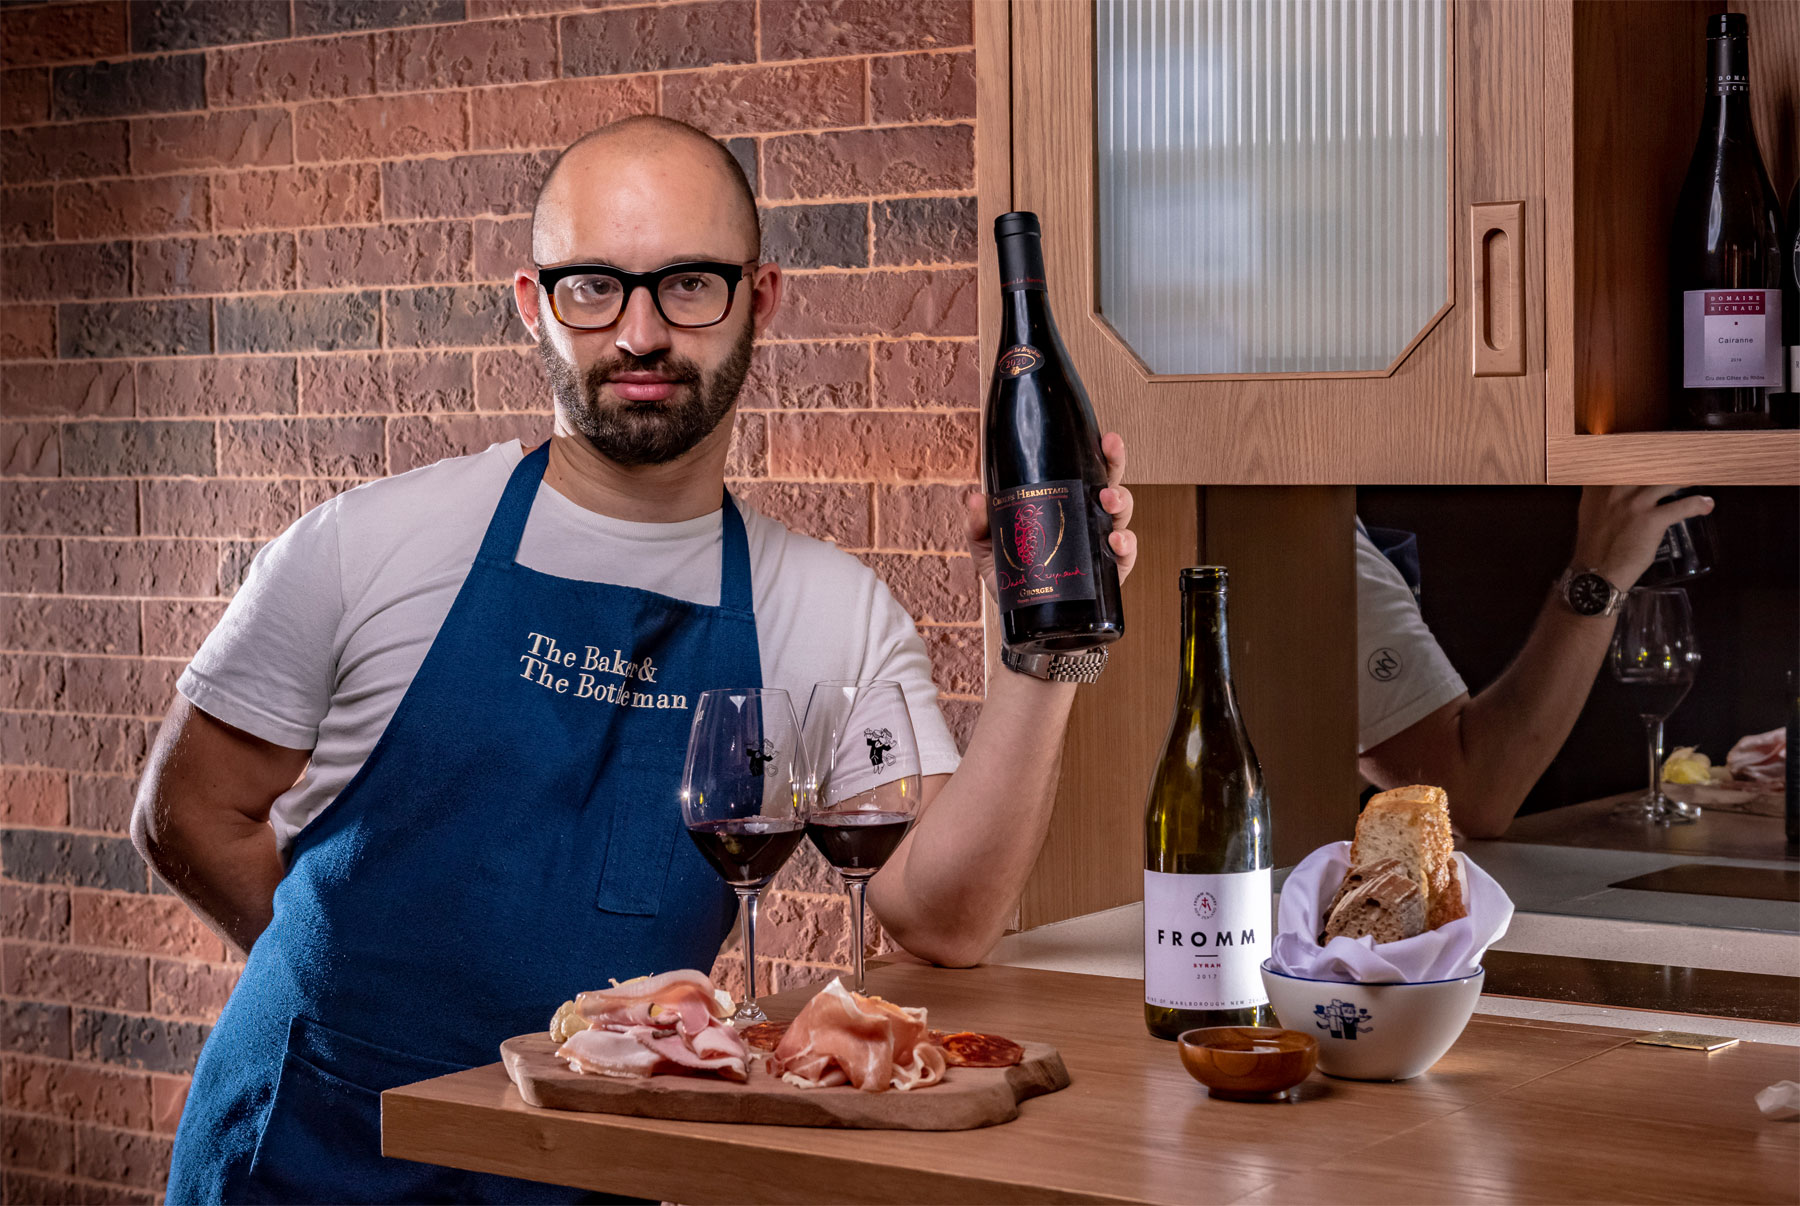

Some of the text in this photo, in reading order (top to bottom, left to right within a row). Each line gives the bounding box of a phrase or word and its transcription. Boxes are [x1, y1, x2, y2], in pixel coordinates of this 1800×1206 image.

[1016, 487, 1069, 499] HERMITAGE
[527, 632, 658, 683] The Baker &
[519, 654, 569, 694] The
[1158, 928, 1255, 947] FROMM
